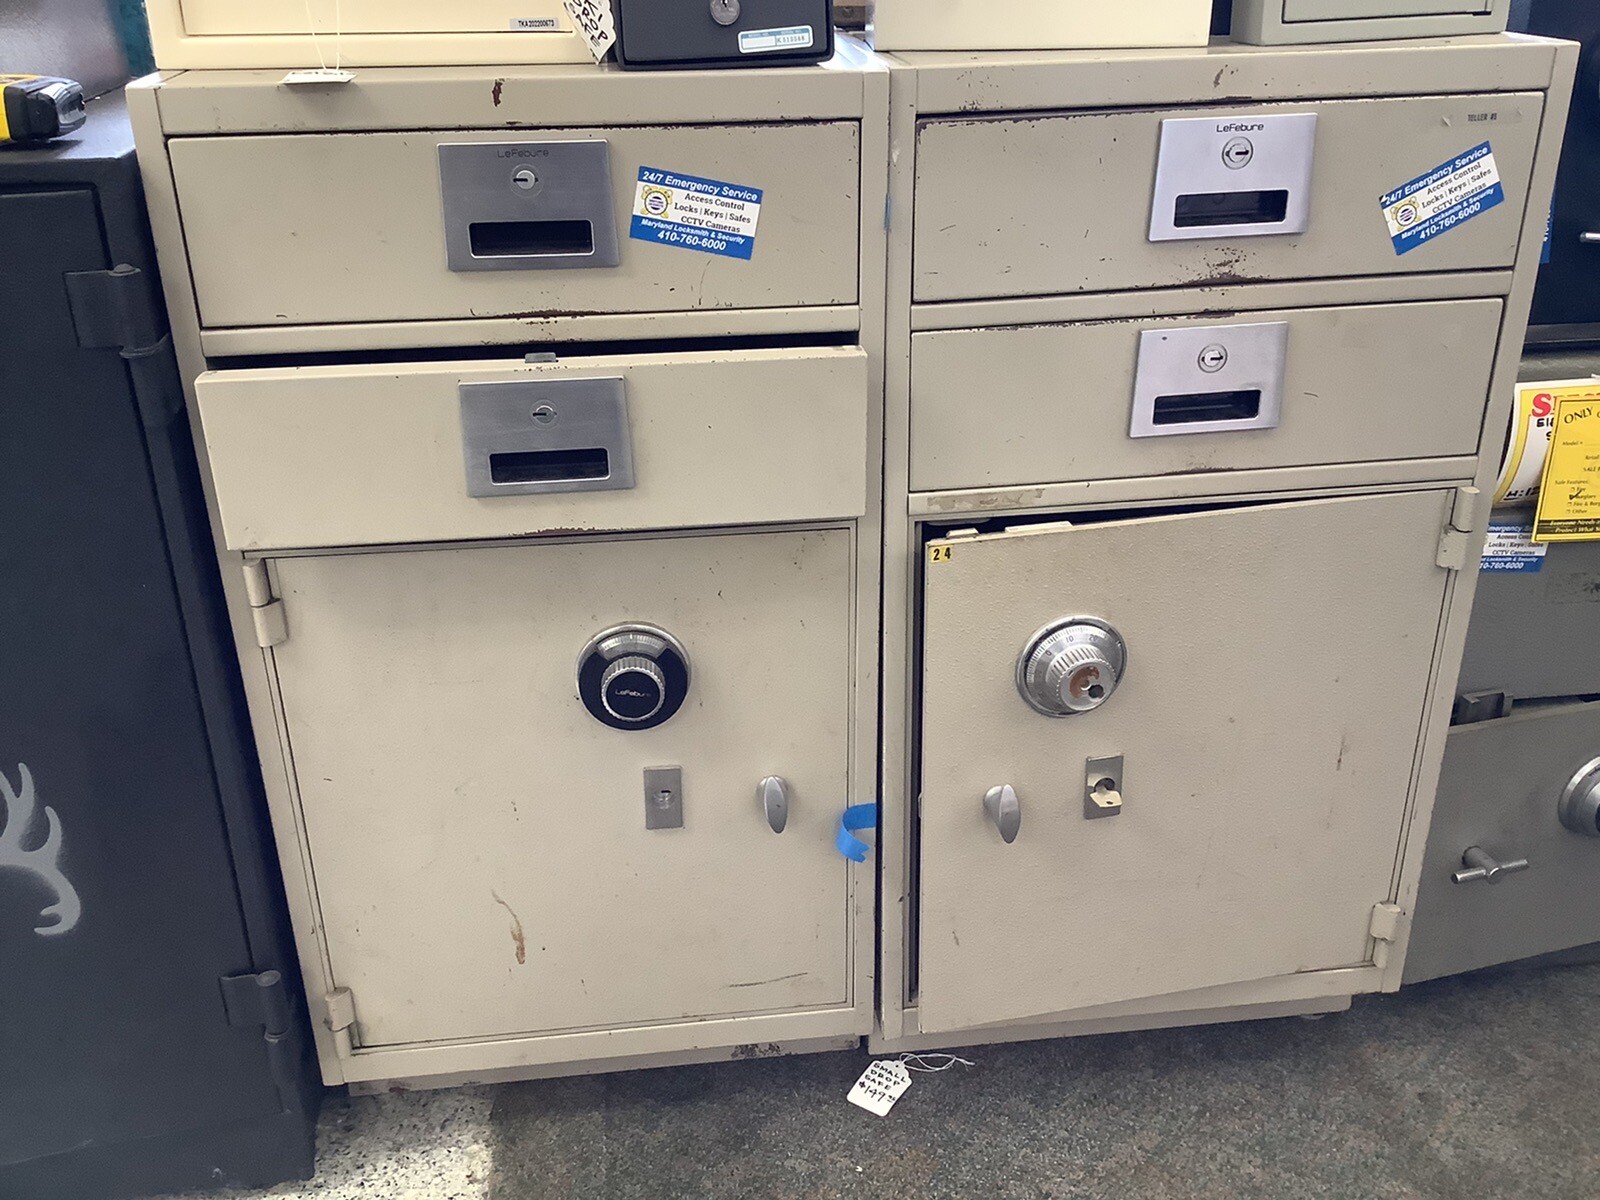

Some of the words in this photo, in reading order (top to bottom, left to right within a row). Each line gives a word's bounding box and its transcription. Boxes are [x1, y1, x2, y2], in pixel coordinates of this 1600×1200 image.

[1216, 123, 1264, 132] LeFebure
[497, 148, 549, 158] LeFebure
[642, 171, 664, 183] 24/7
[665, 175, 720, 195] Emergency
[721, 186, 758, 201] Service
[1385, 190, 1403, 205] 24/7
[1404, 164, 1453, 196] Emergency
[1455, 147, 1488, 168] Service
[1427, 178, 1453, 195] Access
[1453, 162, 1482, 180] Control
[1422, 194, 1444, 209] Locks
[1448, 181, 1467, 195] Keys
[1471, 168, 1492, 183] Safes
[1432, 200, 1453, 214] CCTV
[1454, 182, 1487, 202] Cameras
[684, 193, 714, 205] Access
[715, 199, 745, 211] Control
[674, 203, 698, 214] Locks
[704, 208, 724, 219] Keys
[729, 213, 751, 224] Safes
[1401, 221, 1430, 239] Maryland
[1430, 206, 1462, 225] Locksmith
[1469, 187, 1494, 205] Security
[1420, 202, 1481, 240] 410-760-6000
[640, 218, 674, 232] Maryland
[674, 223, 709, 237] Locksmith
[717, 231, 745, 245] Security
[681, 215, 704, 226] CCTV
[705, 220, 741, 233] Cameras
[658, 230, 727, 251] 410-760-6000
[1564, 406, 1594, 424] ONLY
[614, 688, 652, 698] LeFebure
[864, 1074, 891, 1090] SAFE
[870, 1069, 900, 1086] DROP
